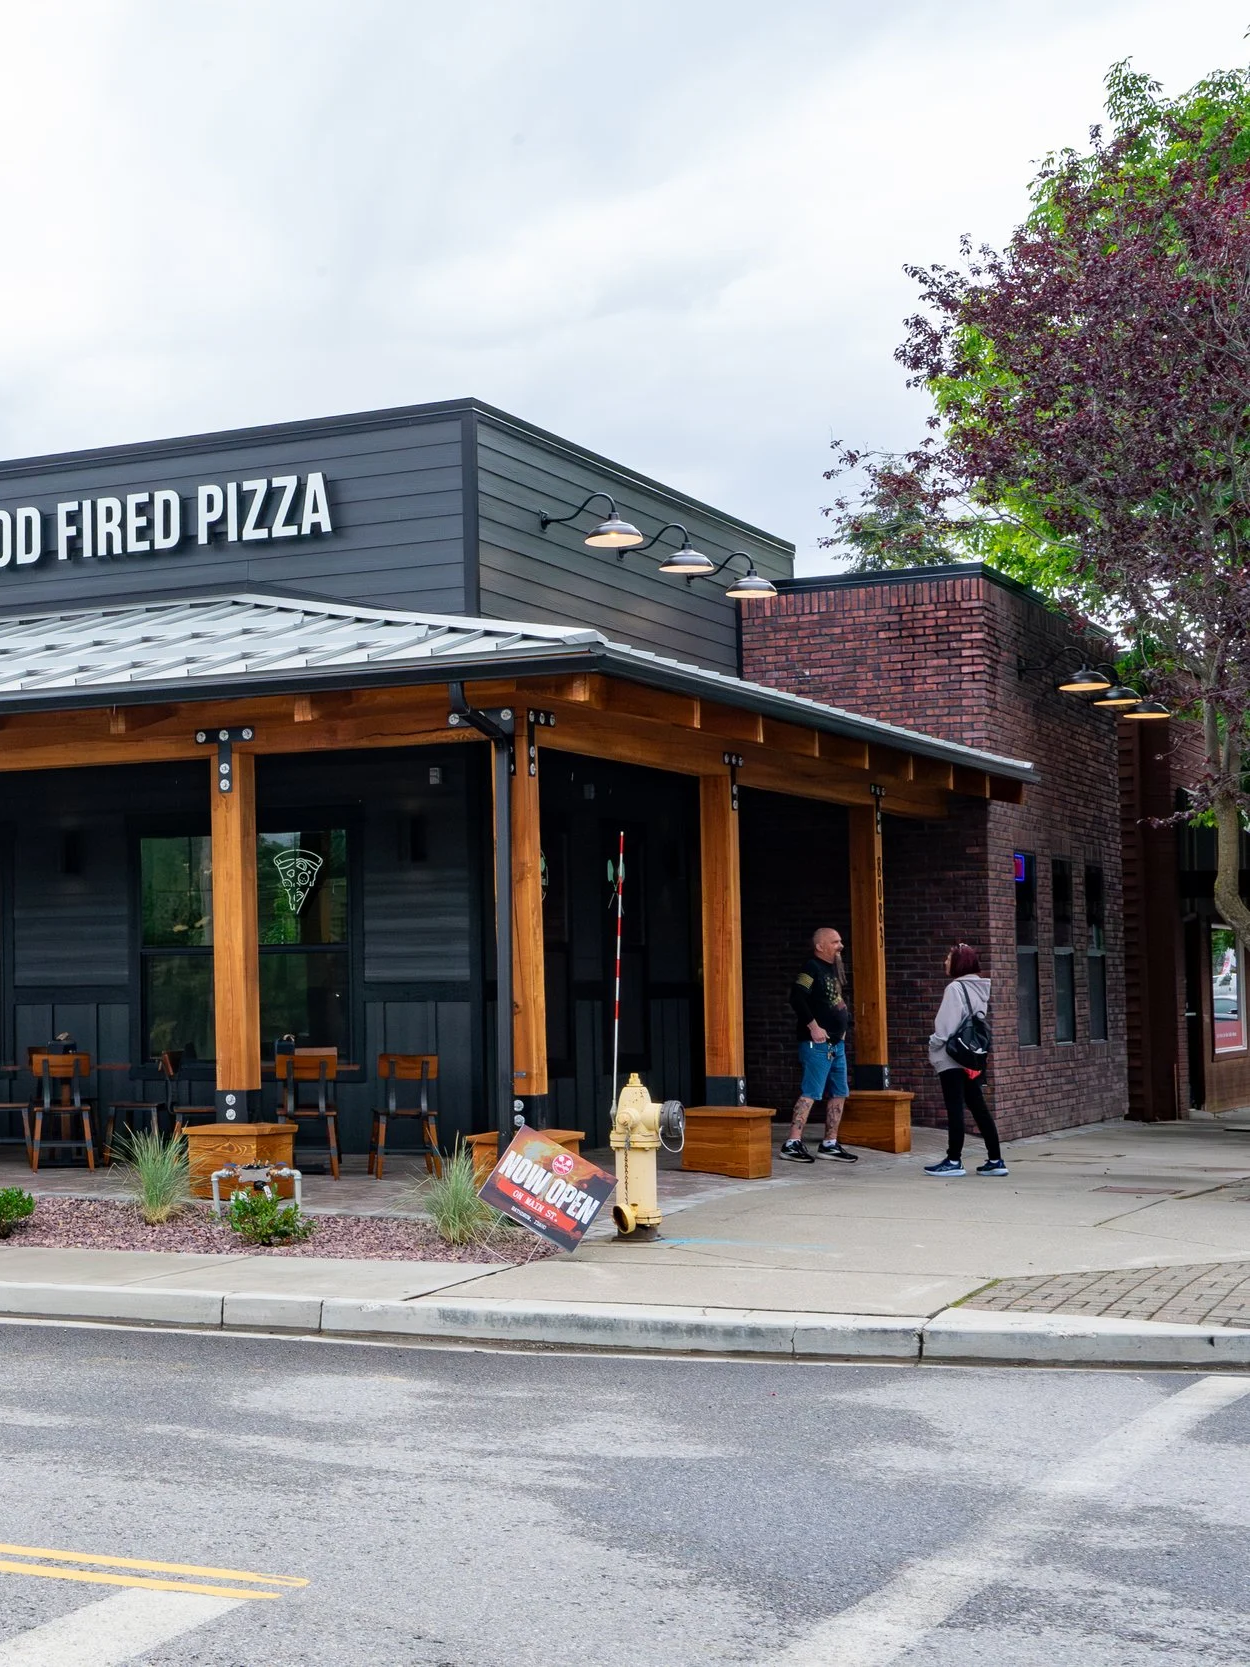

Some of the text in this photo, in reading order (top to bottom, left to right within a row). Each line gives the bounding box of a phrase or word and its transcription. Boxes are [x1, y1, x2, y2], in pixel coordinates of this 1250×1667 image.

[57, 489, 181, 560] FIRED
[197, 472, 332, 545] PIZZA
[498, 1150, 600, 1225] NOW OPEN
[512, 1190, 558, 1222] ON MAIN ST.
